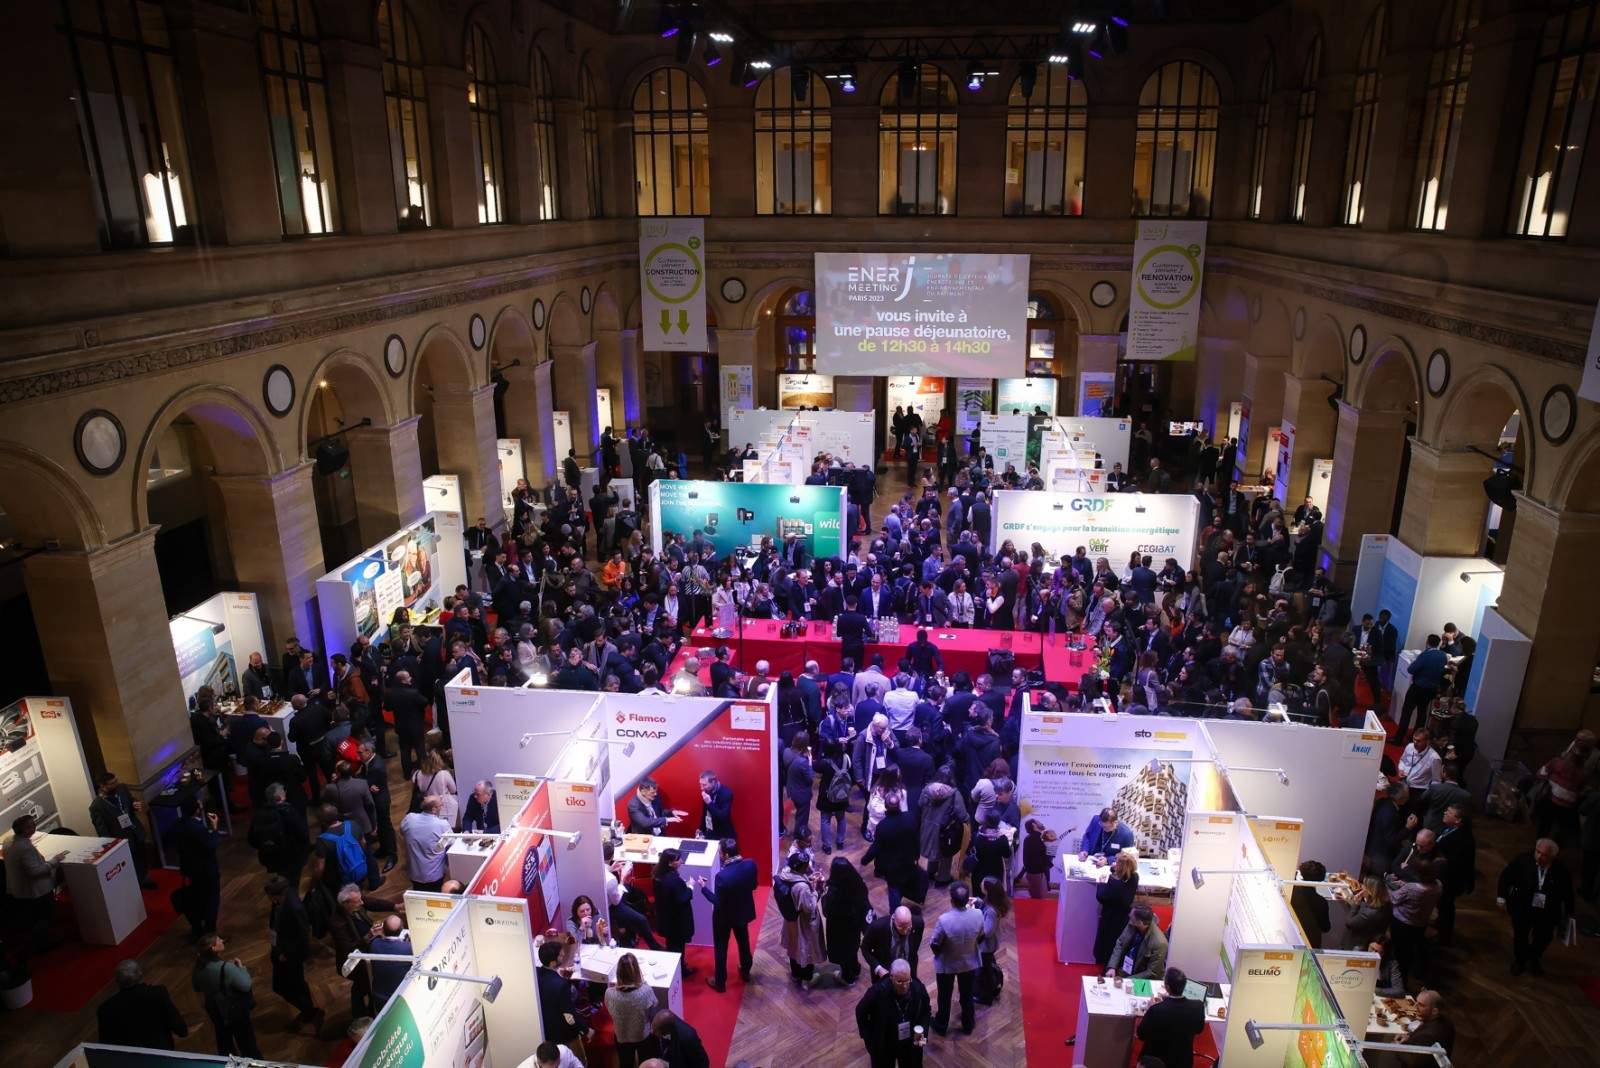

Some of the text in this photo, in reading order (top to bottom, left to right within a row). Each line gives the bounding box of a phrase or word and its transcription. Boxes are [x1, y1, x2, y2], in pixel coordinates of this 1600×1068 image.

[848, 267, 899, 282] ENER
[1141, 273, 1194, 281] RÉNOVATION
[848, 283, 897, 292] MEETING
[876, 310, 968, 322] vous invite à
[834, 325, 1011, 342] une pause déjeunatoire,
[857, 340, 991, 353] de 12h30 à 14h30
[1071, 498, 1114, 512] GRDF
[1026, 524, 1061, 532] s'engage
[1133, 526, 1180, 535] énergétique
[1137, 545, 1176, 553] CEGIBAT
[629, 713, 666, 723] Flamco
[616, 729, 667, 739] COMAP
[1134, 729, 1152, 738] sto
[1071, 761, 1131, 769] l'environnement
[1099, 771, 1128, 779] regards.
[566, 796, 586, 807] tiko
